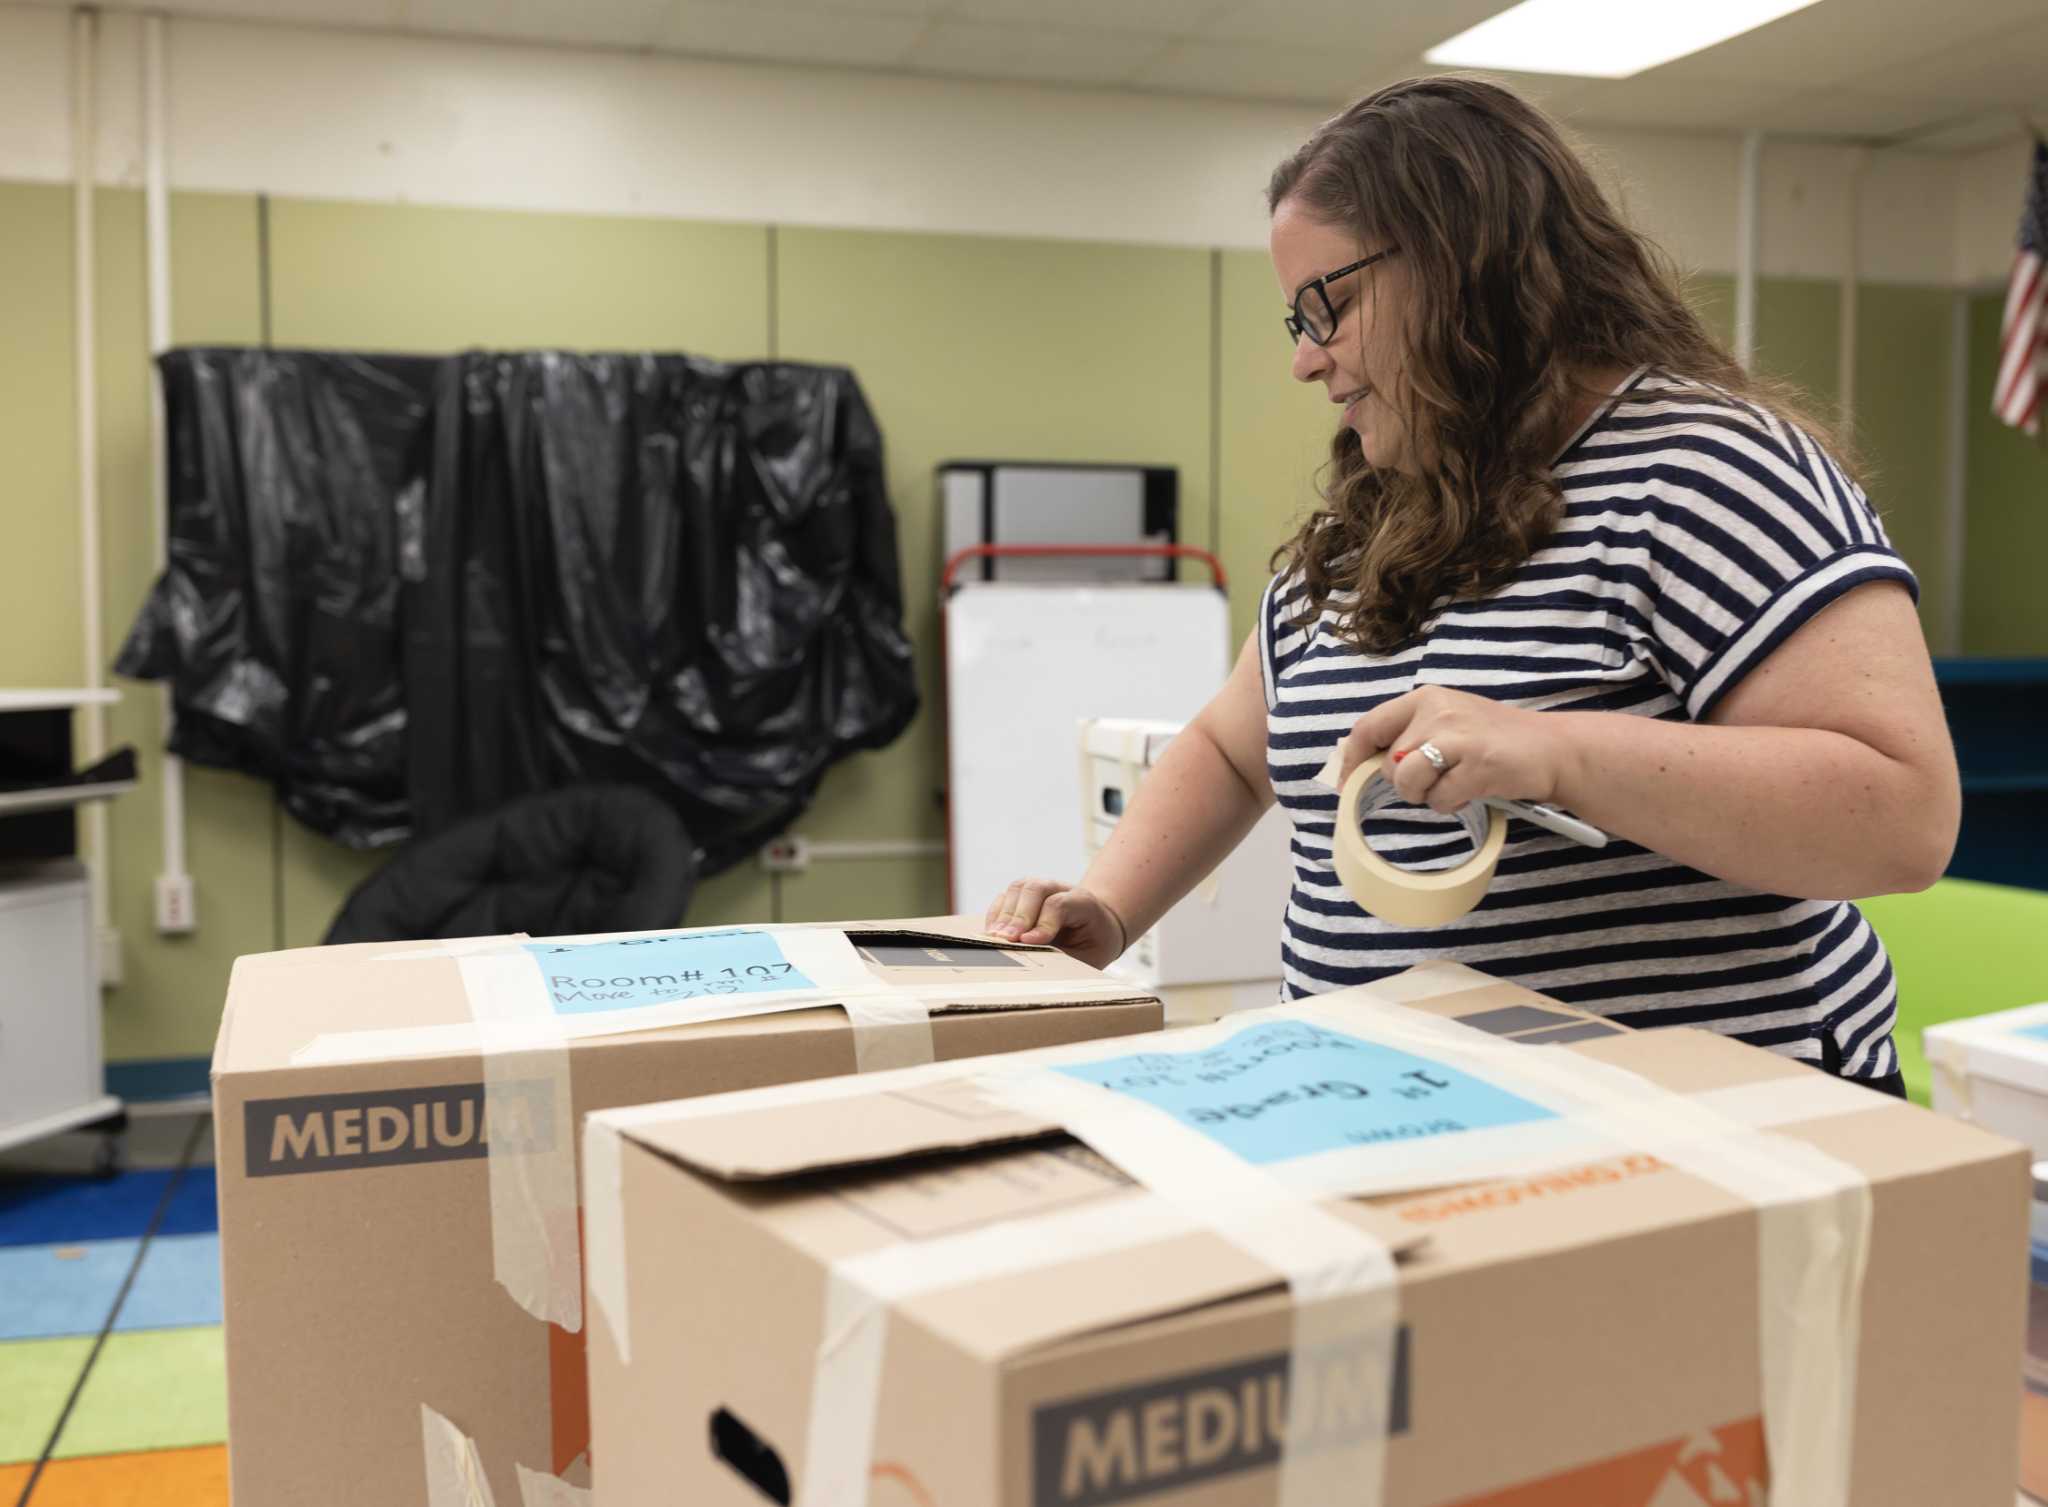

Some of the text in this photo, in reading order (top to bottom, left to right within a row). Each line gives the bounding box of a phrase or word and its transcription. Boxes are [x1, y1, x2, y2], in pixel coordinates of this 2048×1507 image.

[551, 962, 793, 988] Room# 107
[1192, 1079, 1370, 1126] Grade
